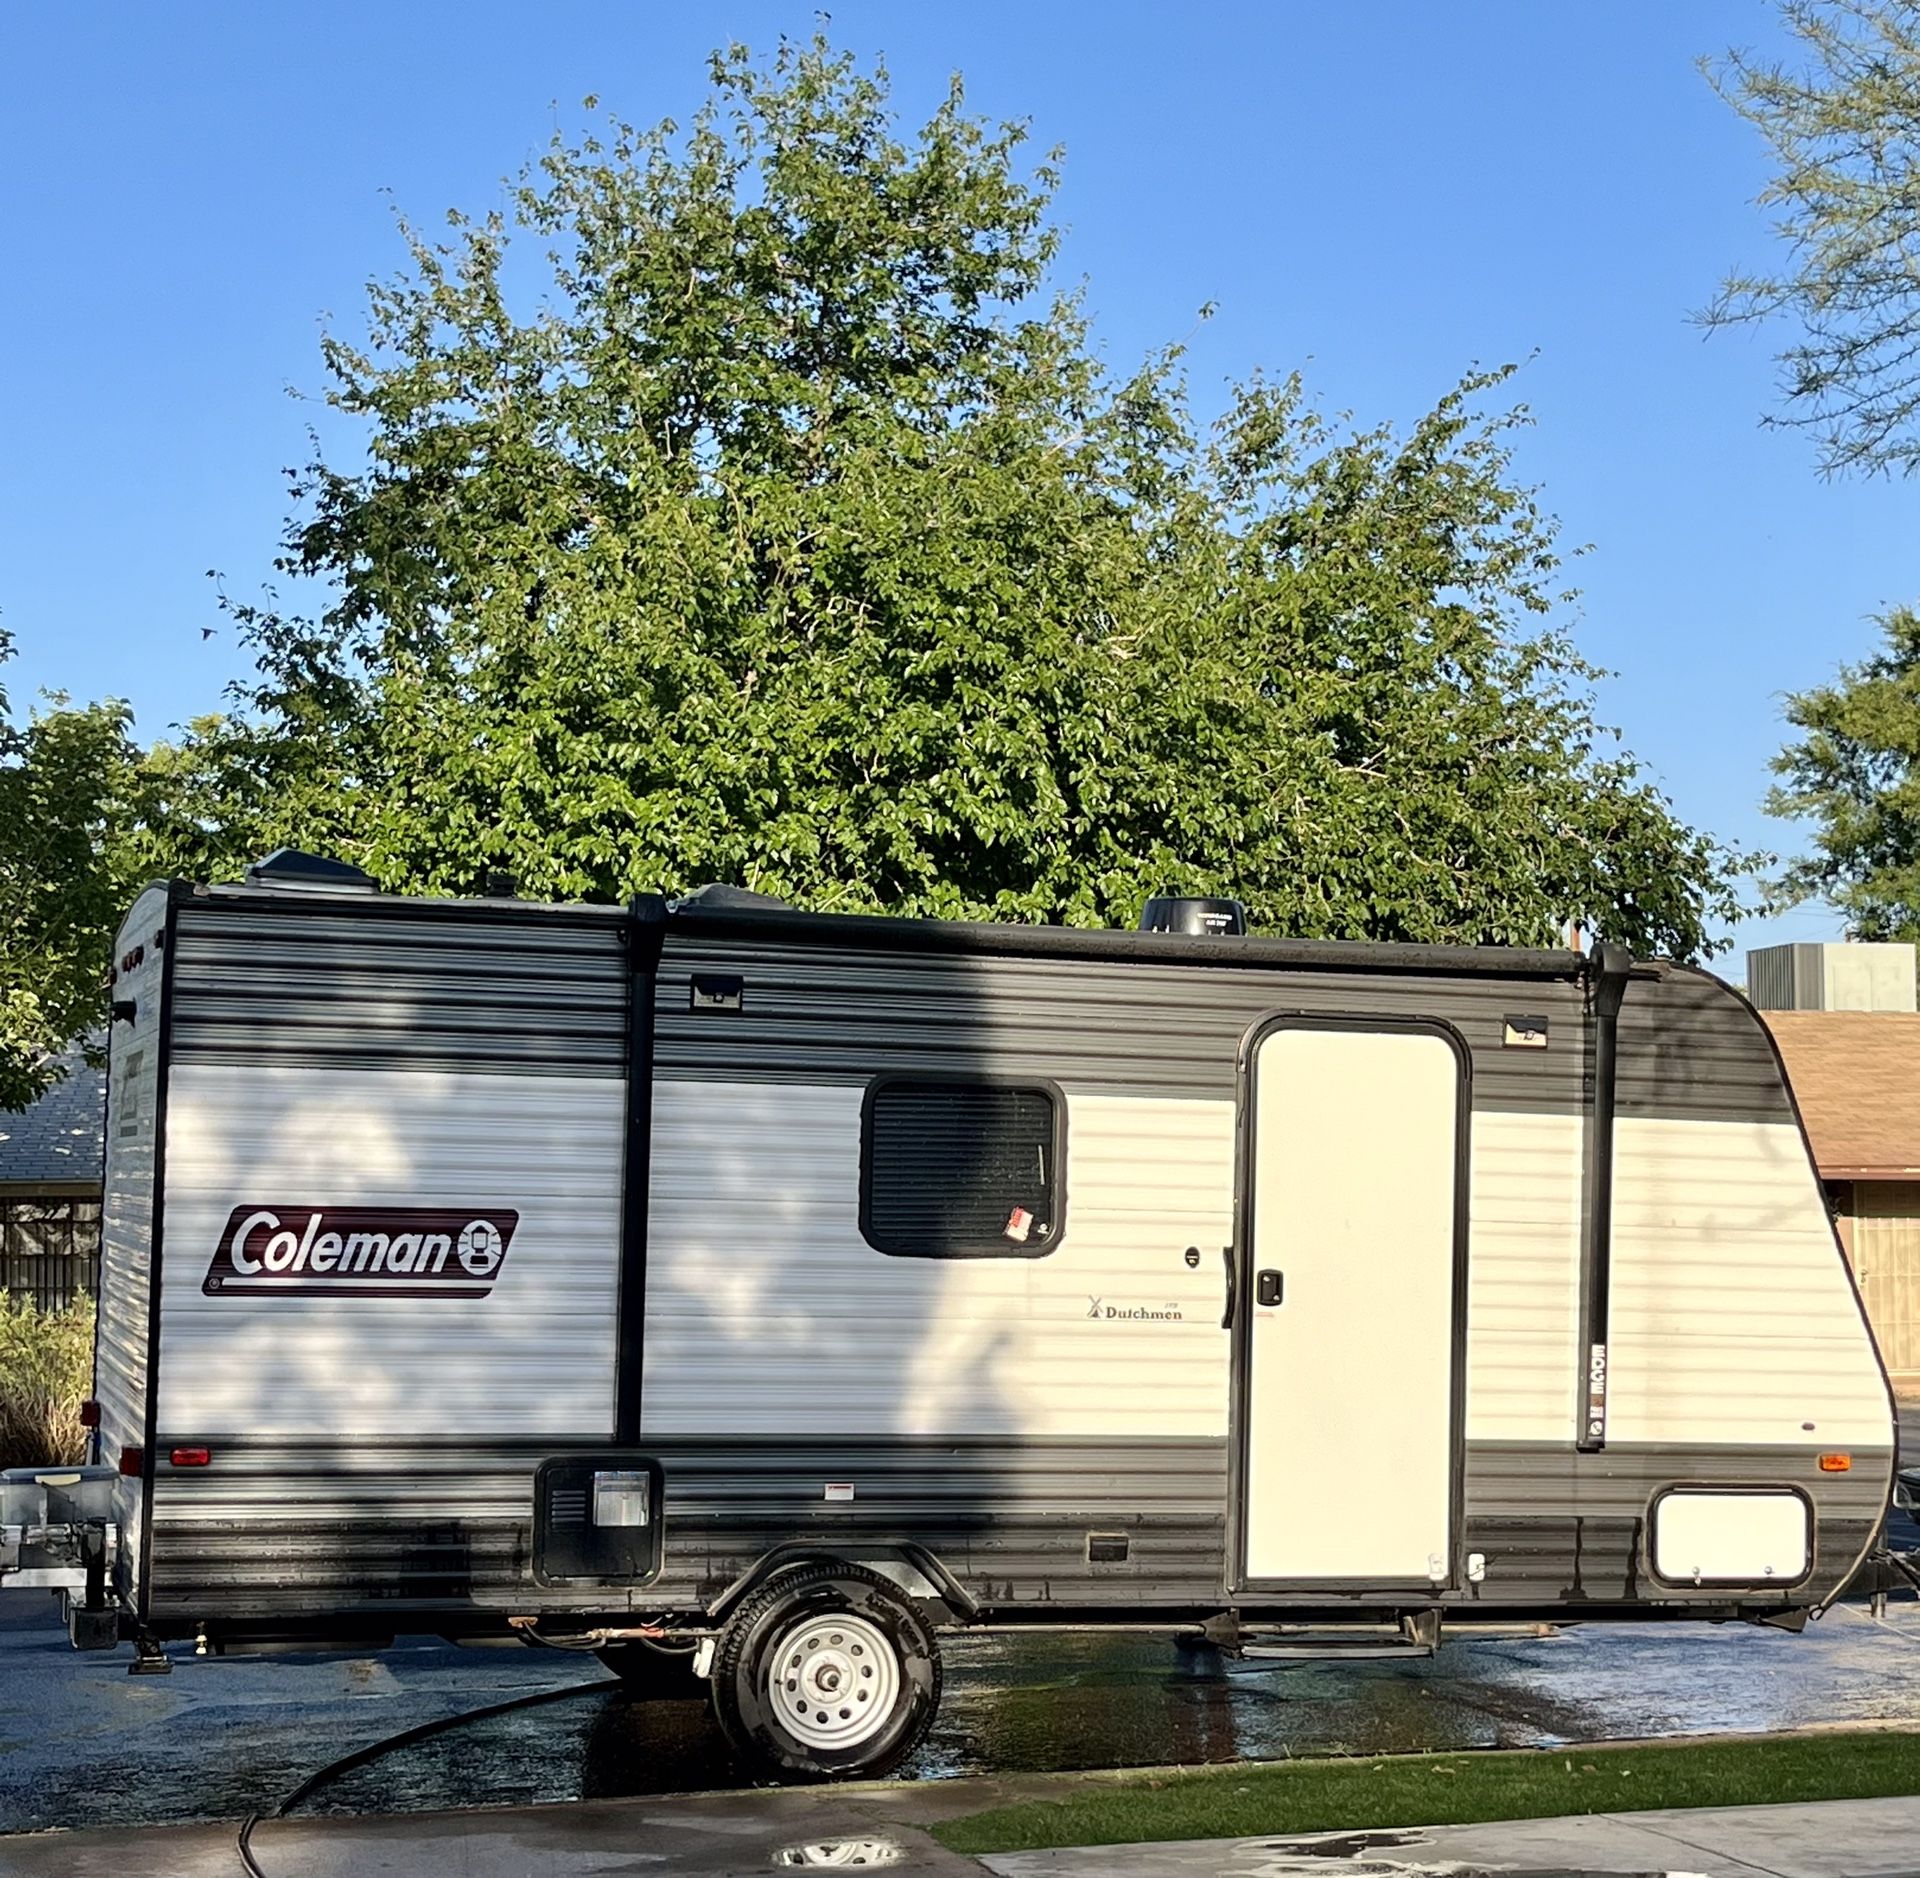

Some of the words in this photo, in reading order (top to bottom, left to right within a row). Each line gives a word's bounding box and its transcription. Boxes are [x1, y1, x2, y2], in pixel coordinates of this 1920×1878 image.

[231, 1211, 452, 1275] Coleman
[1106, 1306, 1183, 1320] Dutchmen
[1590, 1344, 1606, 1395] EDGE
